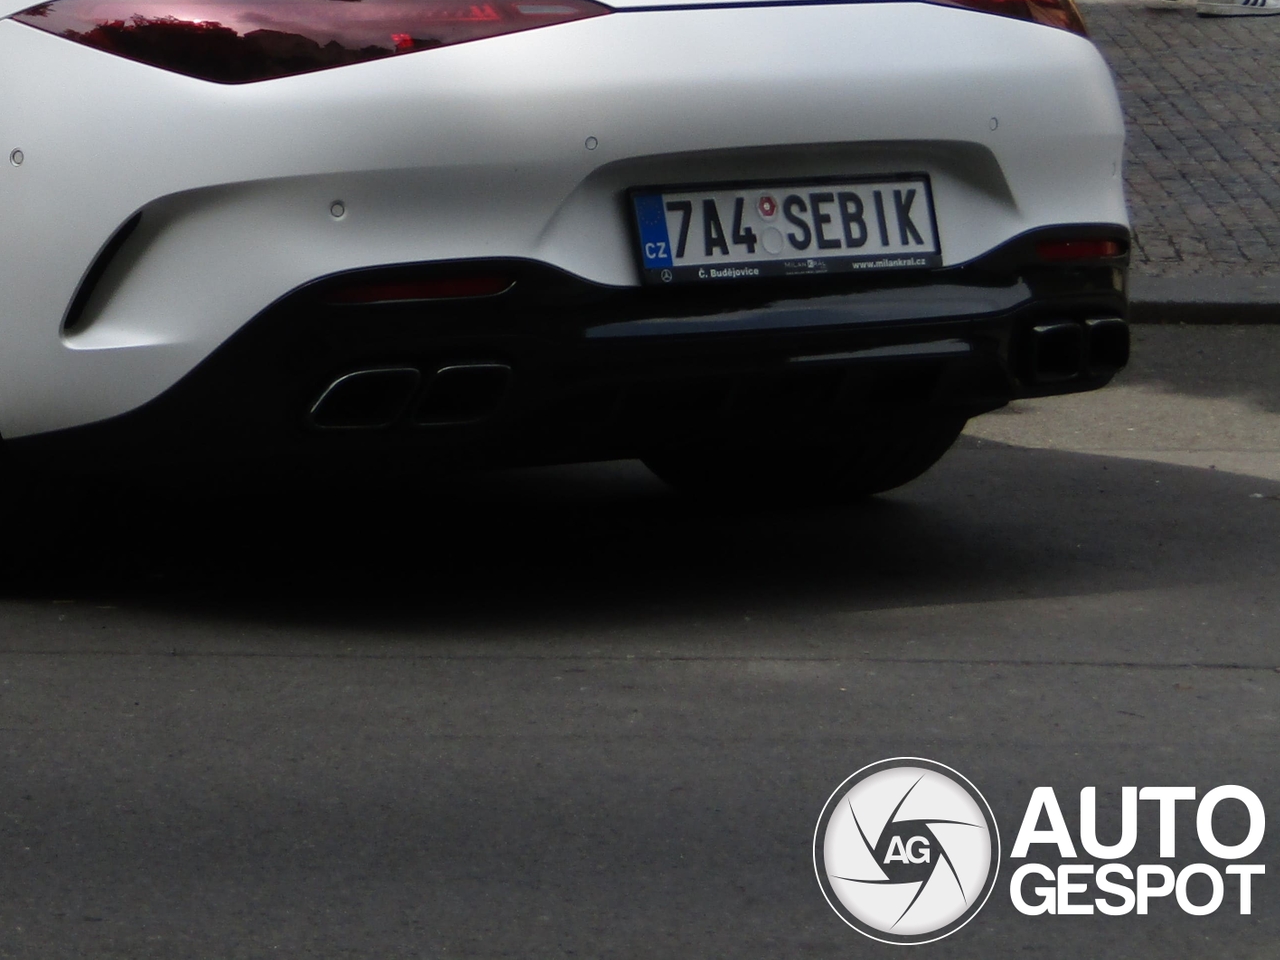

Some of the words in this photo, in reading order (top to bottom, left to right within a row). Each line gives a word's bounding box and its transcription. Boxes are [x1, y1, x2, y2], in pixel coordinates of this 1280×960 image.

[666, 197, 758, 258] 7A4
[783, 189, 924, 252] SEBIK
[645, 241, 668, 259] CZ
[852, 257, 926, 269] www.milankral.cz
[698, 268, 708, 279] Č.
[710, 267, 760, 278] Budějovice
